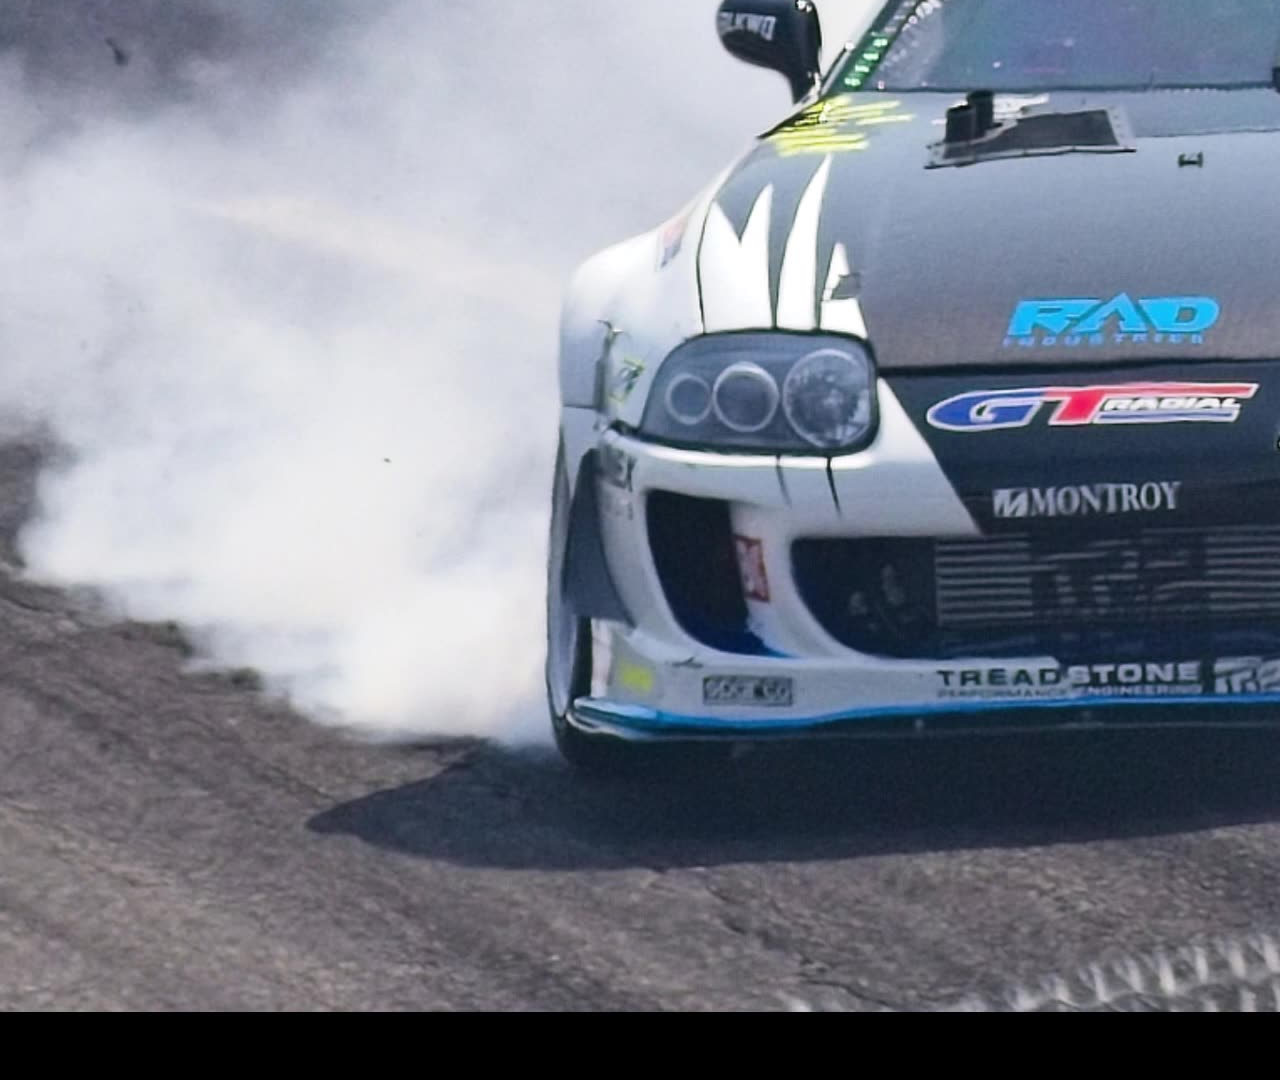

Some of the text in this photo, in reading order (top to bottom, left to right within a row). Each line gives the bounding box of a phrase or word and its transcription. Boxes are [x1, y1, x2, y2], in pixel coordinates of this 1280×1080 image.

[1006, 292, 1221, 336] RAD
[1102, 397, 1241, 411] RADIAL
[1029, 481, 1182, 517] MONTROY
